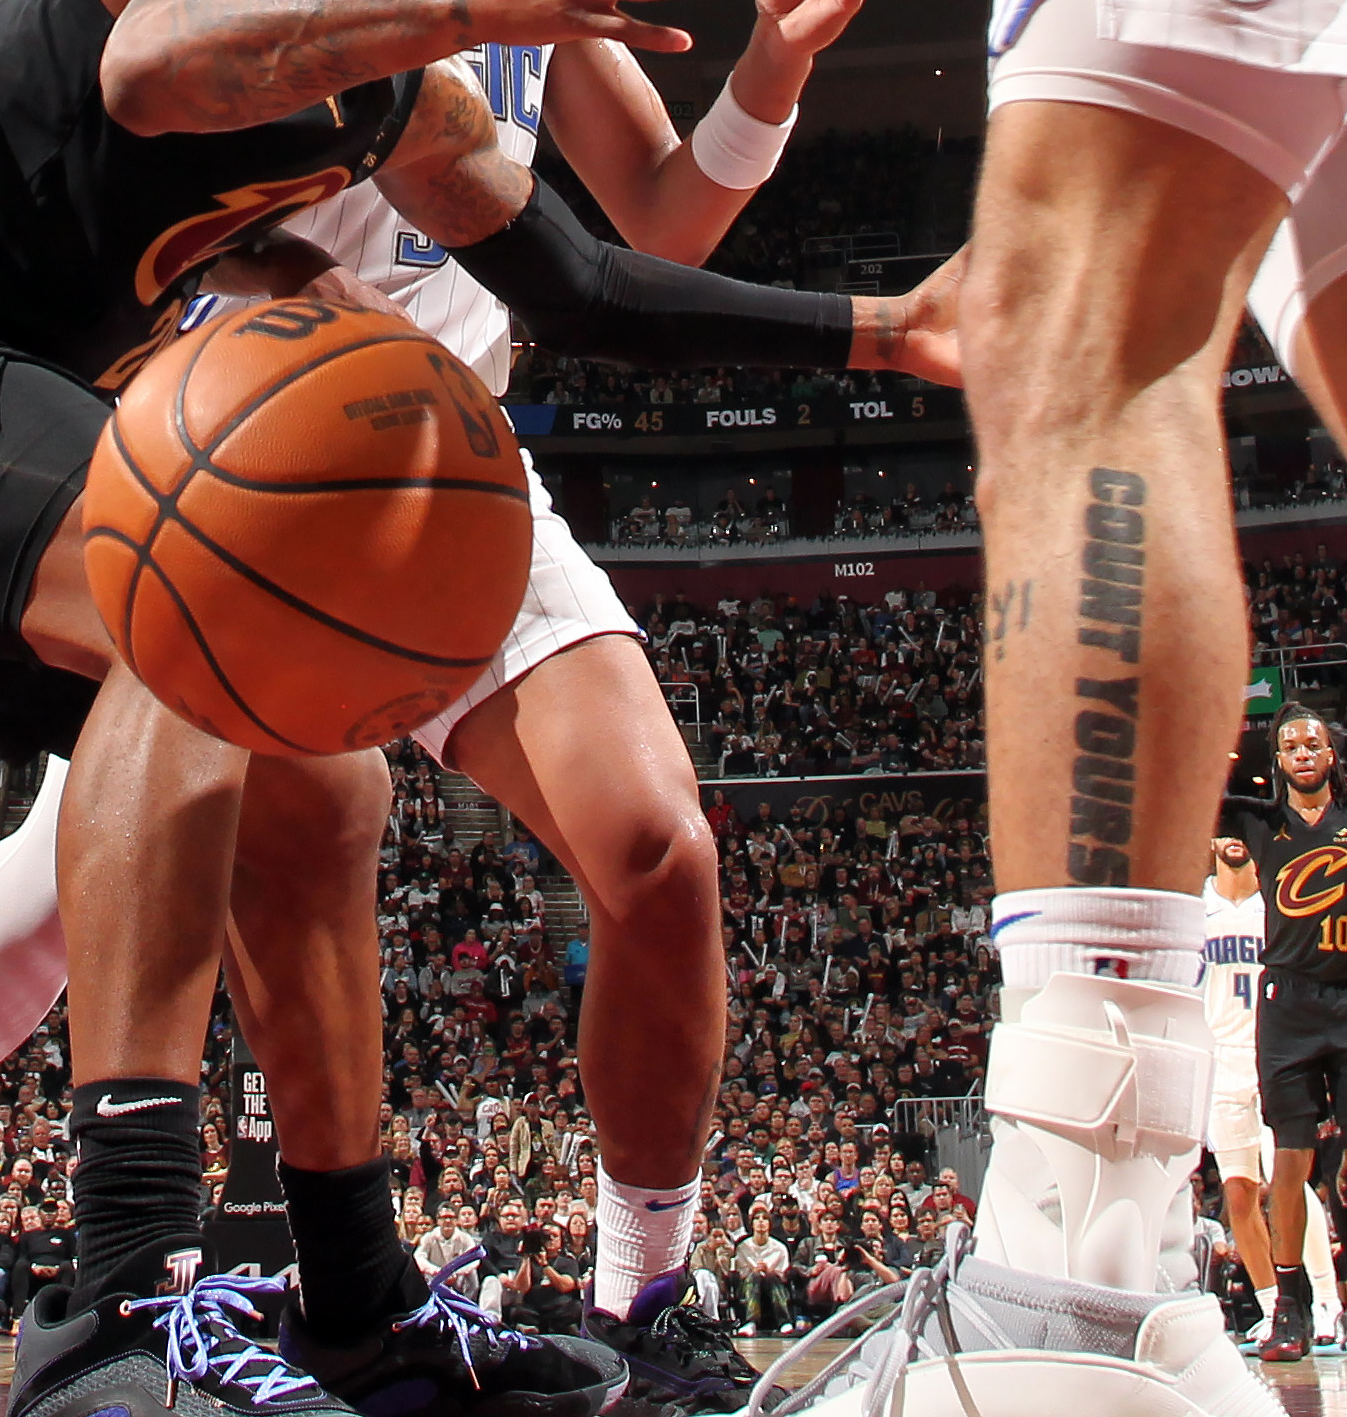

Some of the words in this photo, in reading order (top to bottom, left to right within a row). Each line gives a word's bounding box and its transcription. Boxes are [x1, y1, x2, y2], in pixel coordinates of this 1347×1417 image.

[861, 264, 883, 274] 202
[573, 412, 622, 430] FG%
[634, 411, 664, 432] 45
[706, 407, 777, 427] FOULS
[798, 405, 811, 425] 2
[850, 401, 893, 420] TOL
[912, 397, 924, 417] 5
[834, 562, 875, 577] M102
[1078, 467, 1147, 663] COUNT
[1234, 973, 1252, 1009] 4
[243, 1094, 267, 1114] THE
[248, 1117, 272, 1142] App
[224, 1202, 261, 1214] Google
